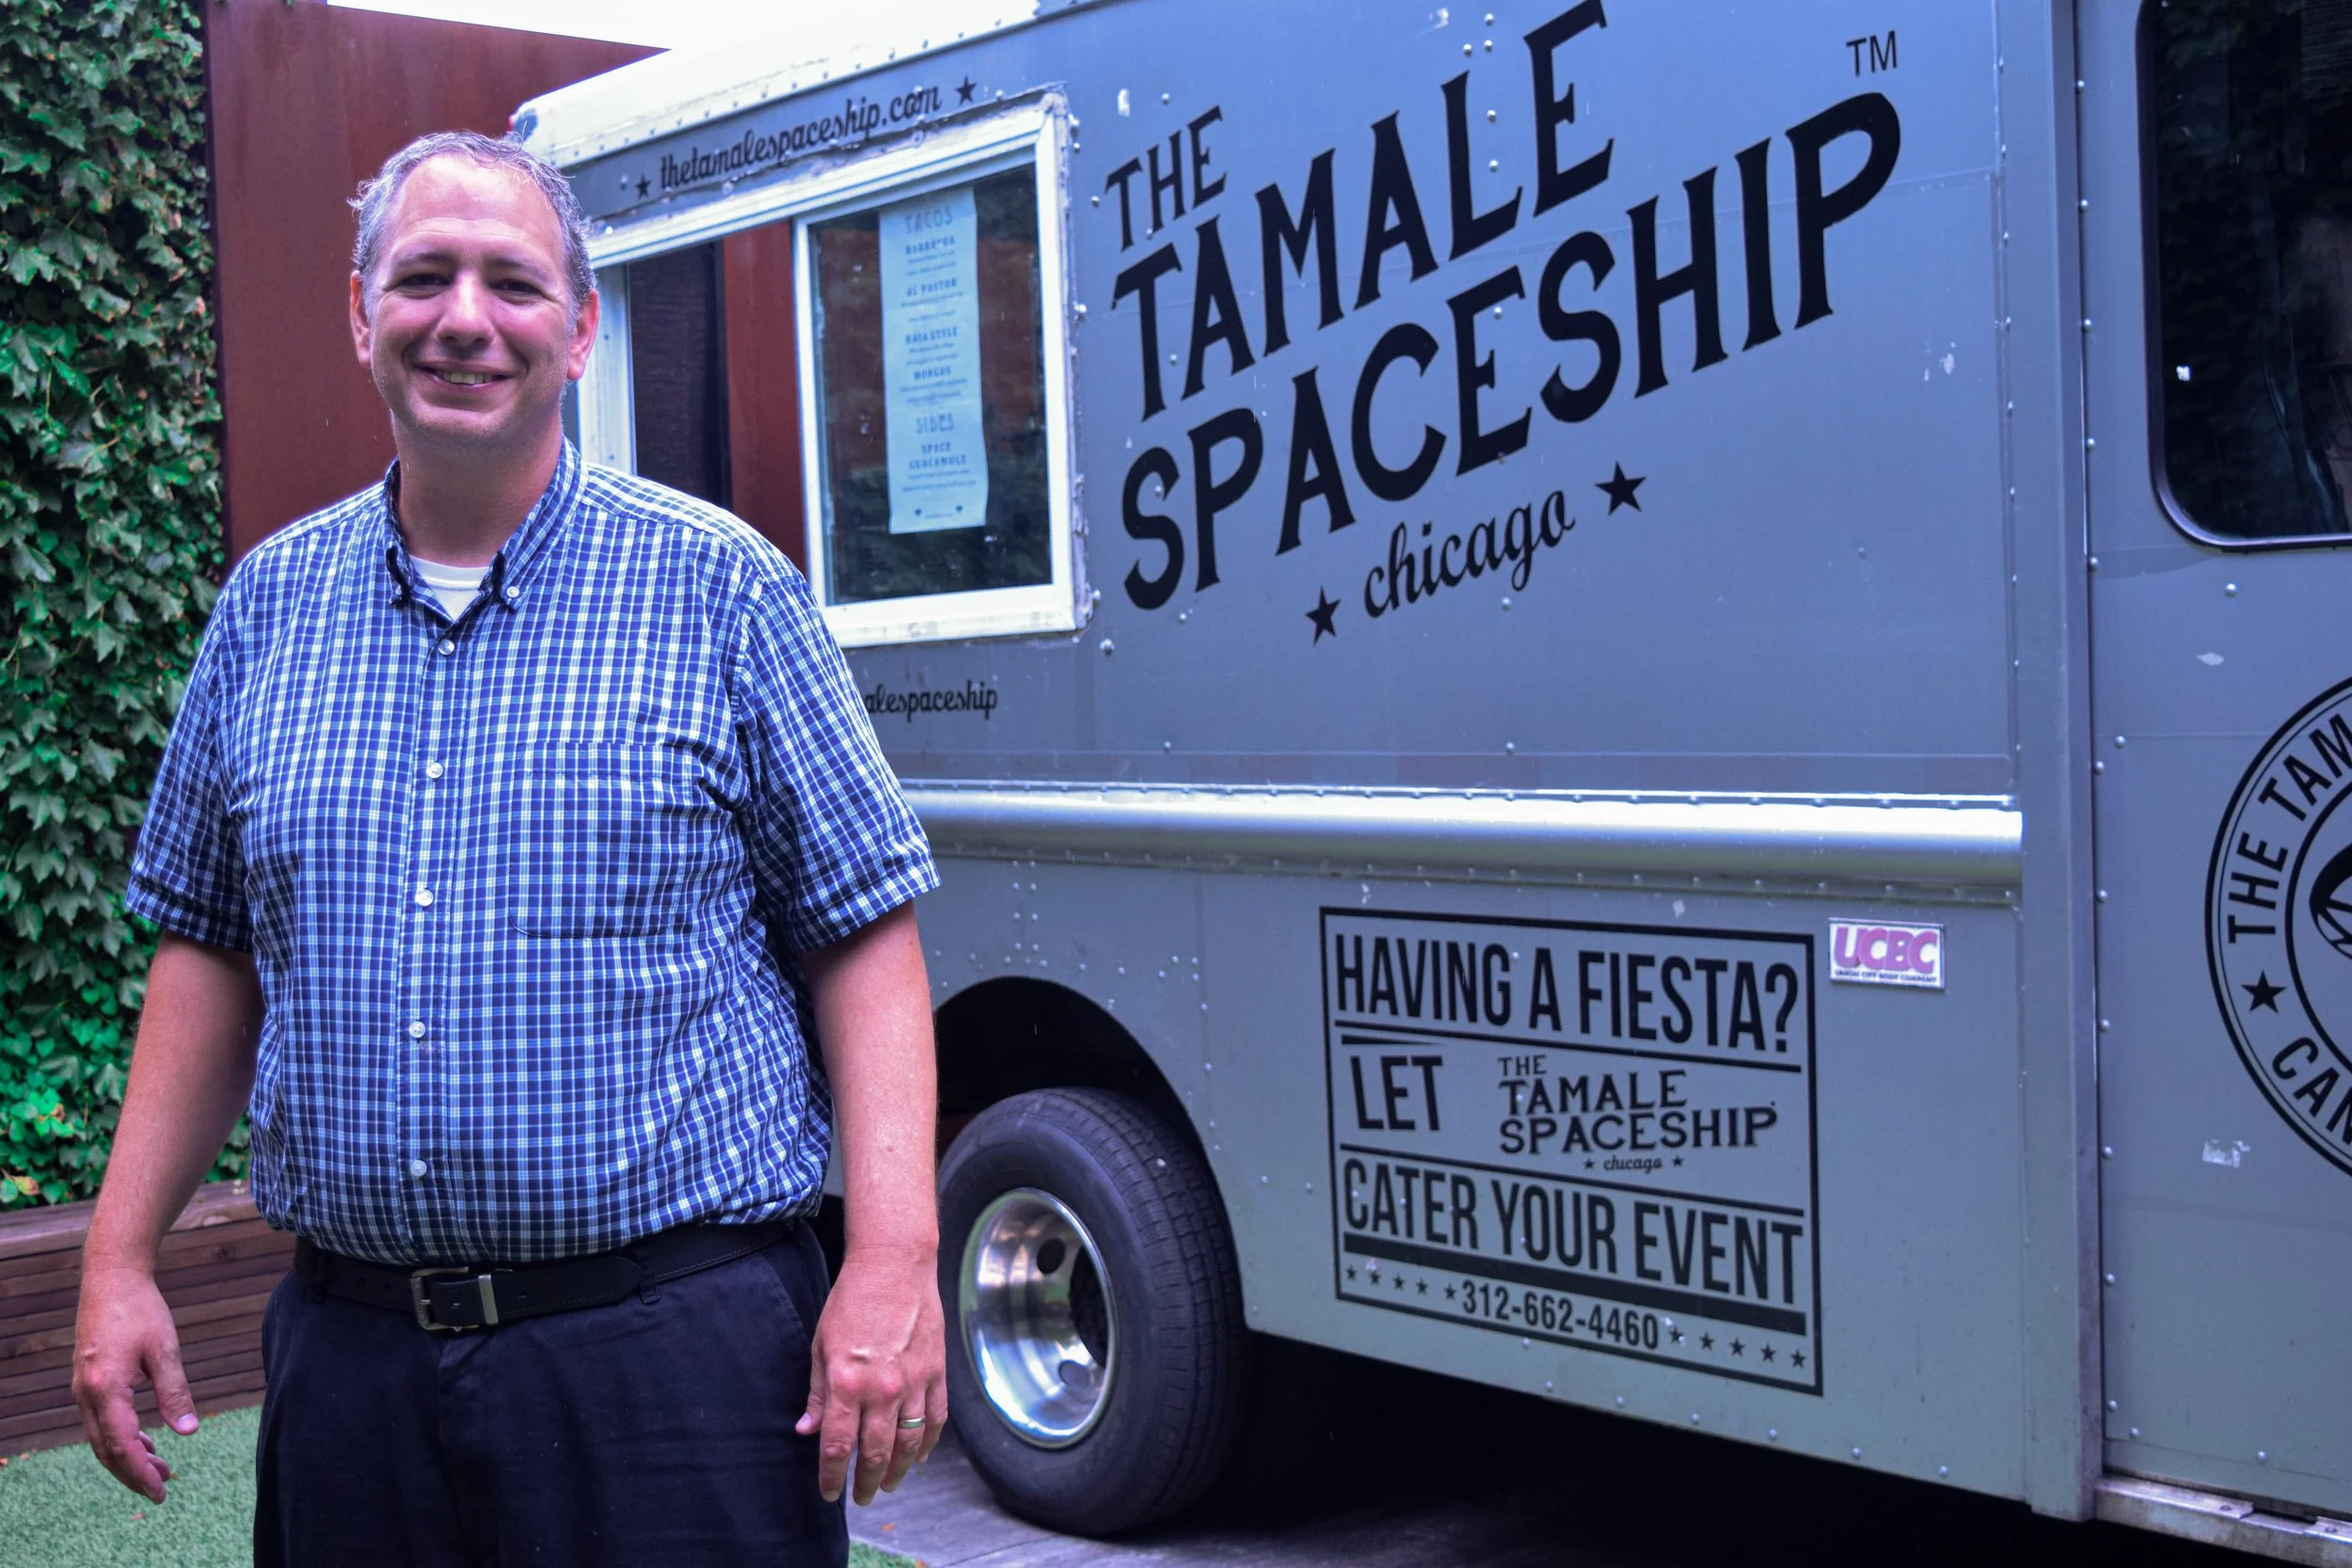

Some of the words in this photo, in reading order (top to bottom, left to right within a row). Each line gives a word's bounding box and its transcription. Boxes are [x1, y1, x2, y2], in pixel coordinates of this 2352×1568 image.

[1846, 31, 1898, 77] TM
[660, 85, 943, 192] thetamalespaceship.com
[1105, 105, 1227, 251] THE
[1111, 0, 1614, 422] TAMALE
[904, 205, 954, 234] TACOS
[922, 277, 958, 294] PASTOR
[1122, 91, 1901, 611] SPACESHIP
[915, 412, 955, 434] SIDES
[1364, 490, 1576, 619] chicago
[2228, 832, 2289, 944] THE
[1835, 927, 1938, 974] UCBC
[1335, 933, 1511, 1026] HAVING
[1528, 947, 1562, 1032] A
[1578, 949, 1799, 1054] FIESTA?
[1349, 1054, 1443, 1132] LET
[1498, 1054, 1547, 1076] THE
[1498, 1069, 1688, 1116] TAMALE
[1500, 1105, 1778, 1155] SPACESHIP
[1603, 1155, 1662, 1174] chicago
[1343, 1158, 1478, 1250] CATER
[1491, 1180, 1616, 1274] YOUR
[1634, 1201, 1804, 1305] EVENT
[1461, 1280, 1660, 1351] 312-662-4460
